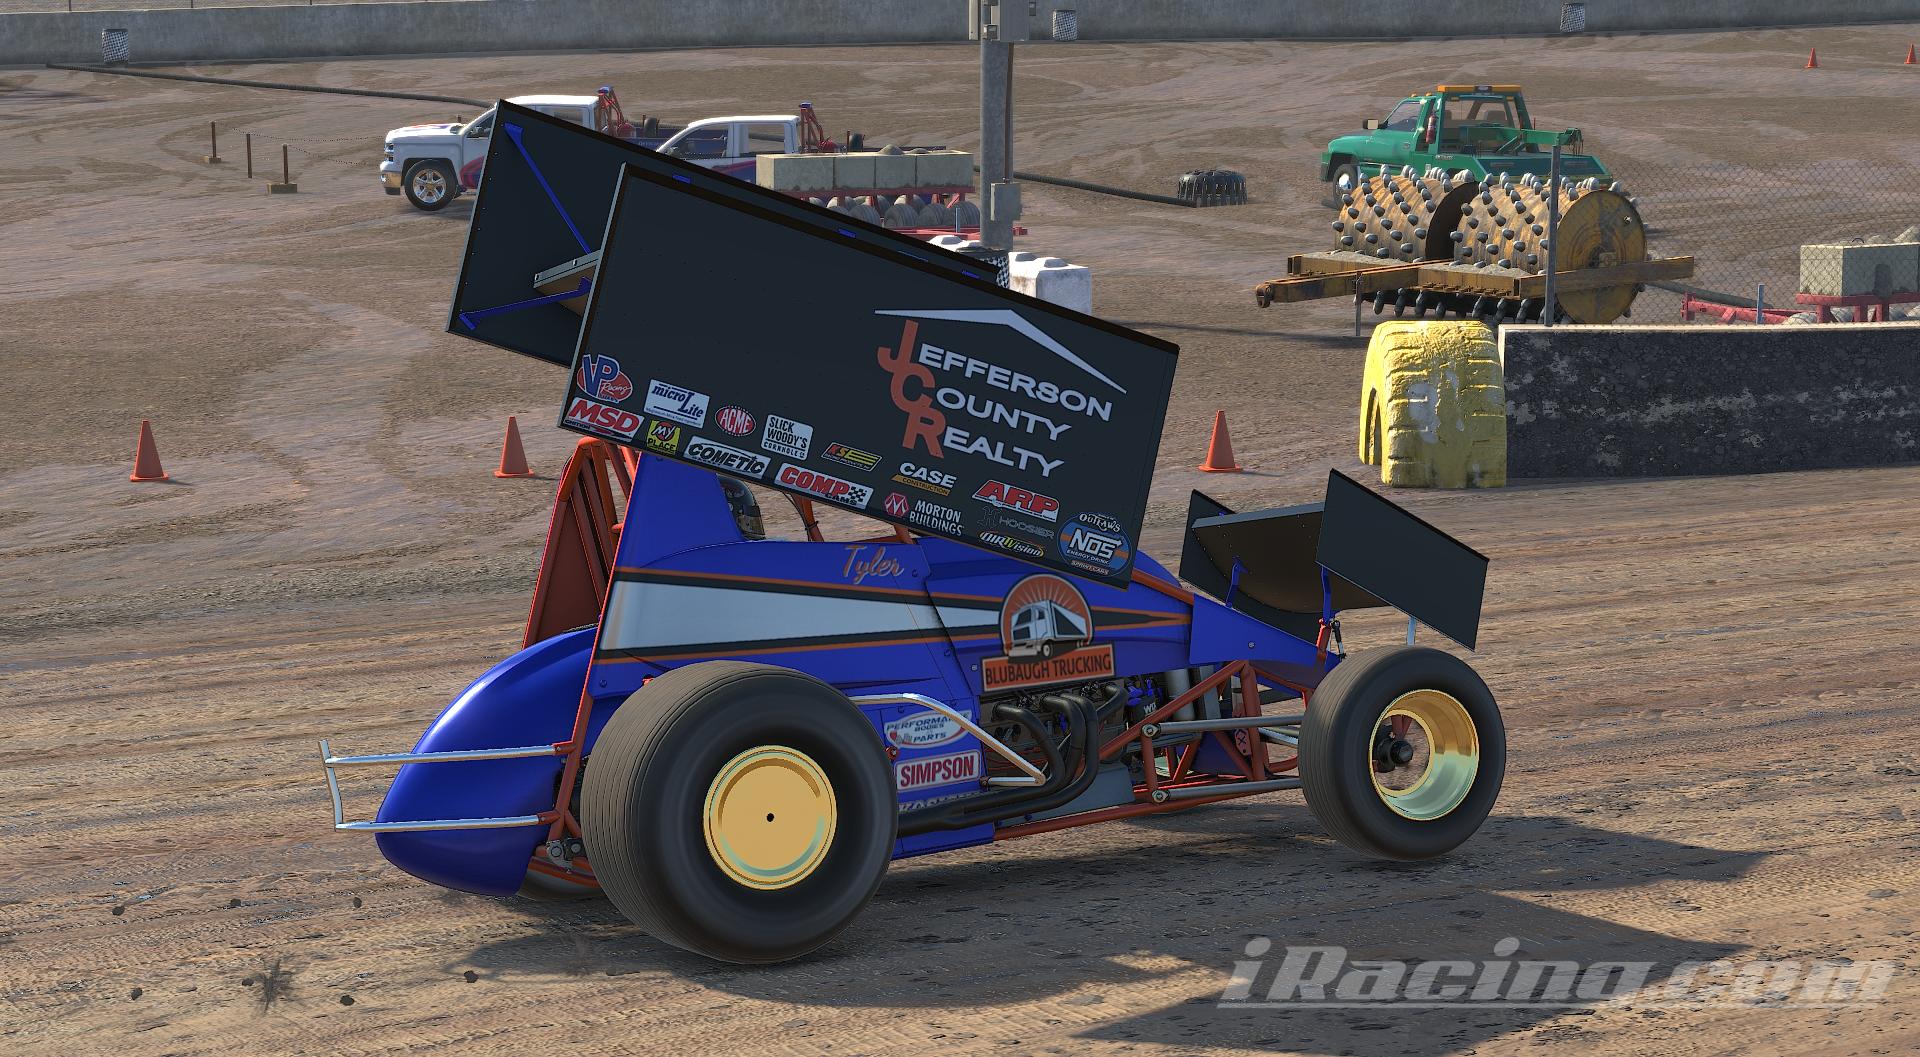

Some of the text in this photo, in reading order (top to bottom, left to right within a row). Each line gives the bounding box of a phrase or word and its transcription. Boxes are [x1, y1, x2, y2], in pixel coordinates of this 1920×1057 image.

[582, 354, 619, 397] VP
[877, 319, 1112, 421] JEFFERSON
[568, 400, 640, 433] MSD
[890, 362, 1072, 441] COUNTY
[719, 408, 753, 434] ACME
[769, 416, 794, 434] SLICK
[648, 438, 676, 452] PLACE
[767, 427, 808, 449] WOODY'S
[902, 406, 1064, 478] REALTY
[688, 443, 765, 474] COMETIC
[780, 466, 851, 497] COMP
[900, 462, 957, 489] CASE
[902, 477, 949, 495] CONSTRUCTION
[914, 499, 962, 523] MORTON
[975, 481, 1059, 514] ARP
[909, 511, 964, 536] BUILDINGS
[1069, 528, 1122, 559] NOS
[843, 545, 905, 585] Tyler
[986, 653, 1112, 685] BLUBAUGH TRUCKING
[913, 732, 947, 743] PARTS
[900, 755, 975, 788] SIMPSON
